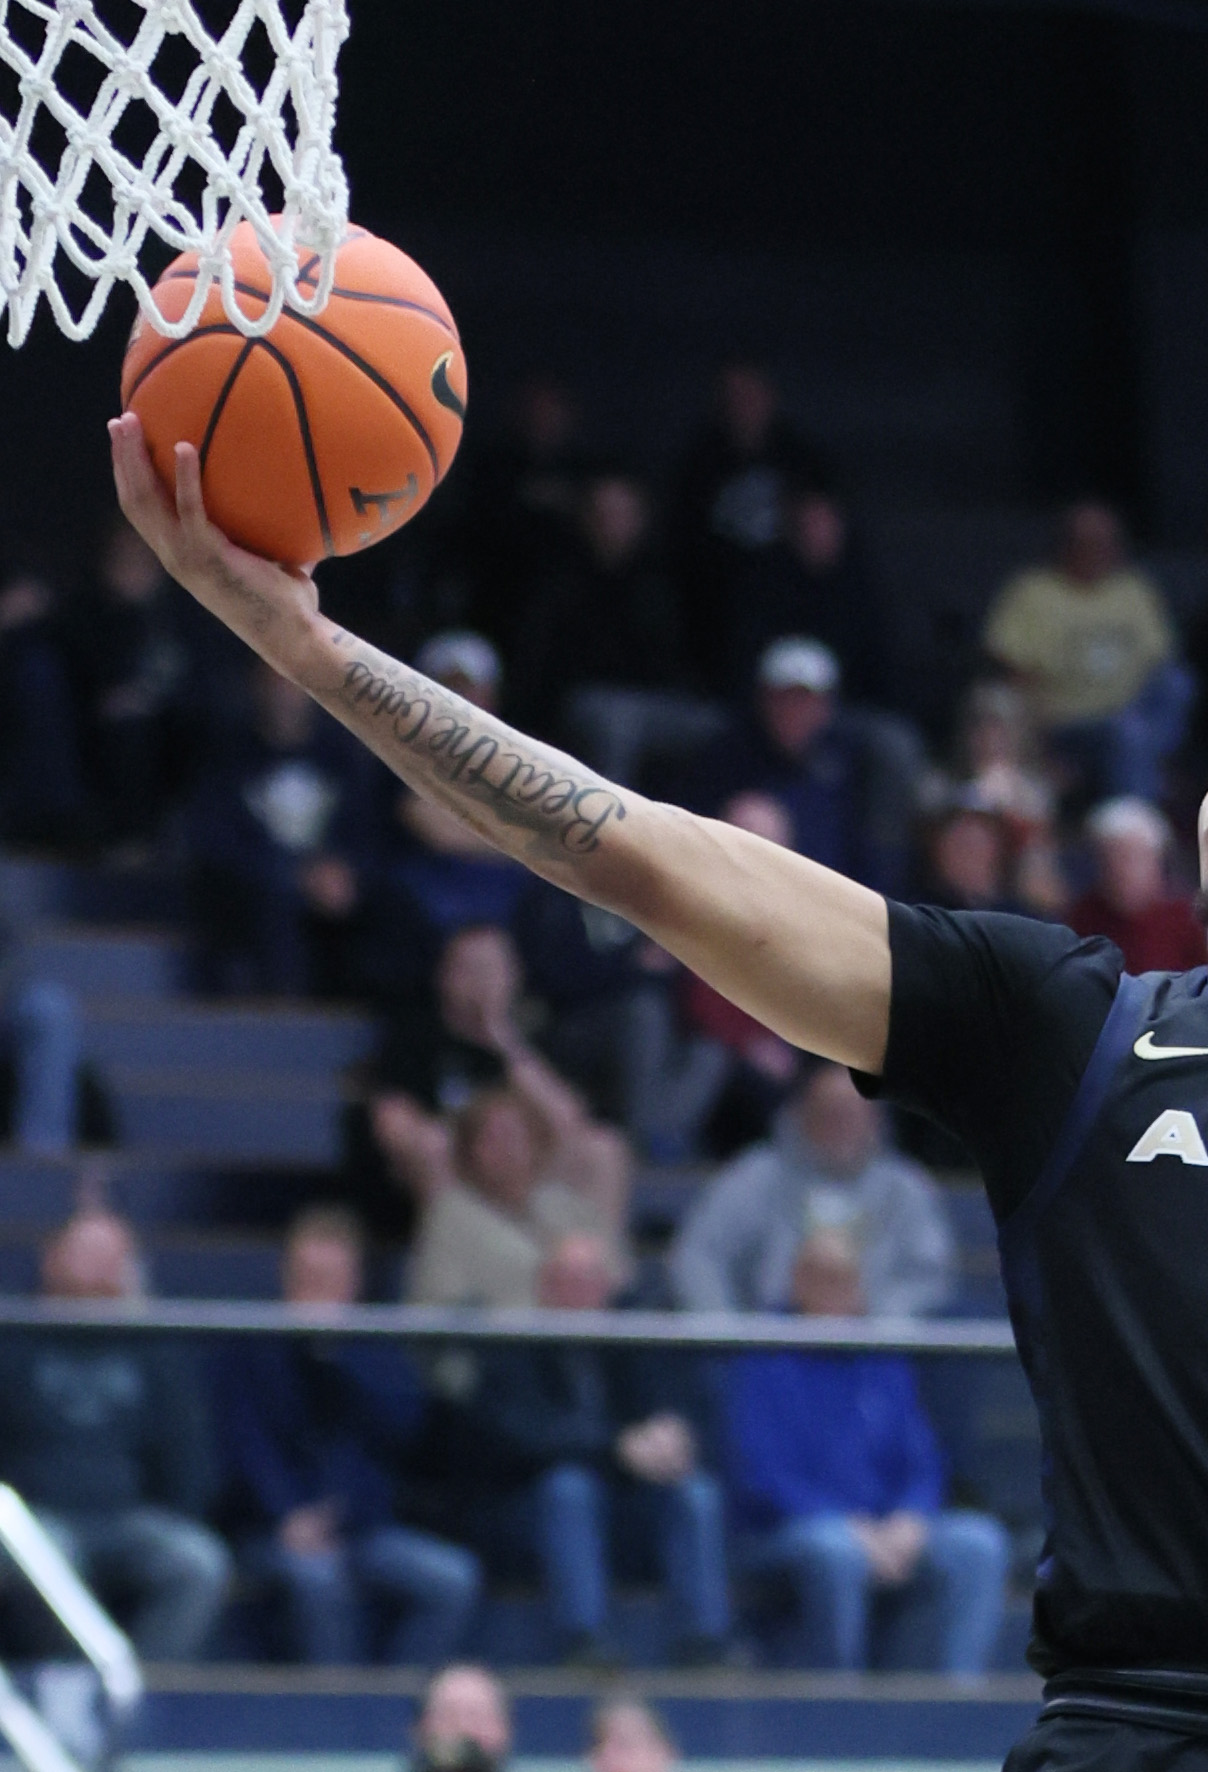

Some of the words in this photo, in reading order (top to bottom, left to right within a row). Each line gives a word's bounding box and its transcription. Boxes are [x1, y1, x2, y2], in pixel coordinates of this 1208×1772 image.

[344, 660, 432, 744] Odds
[430, 716, 499, 782] the
[499, 752, 627, 856] Beat
